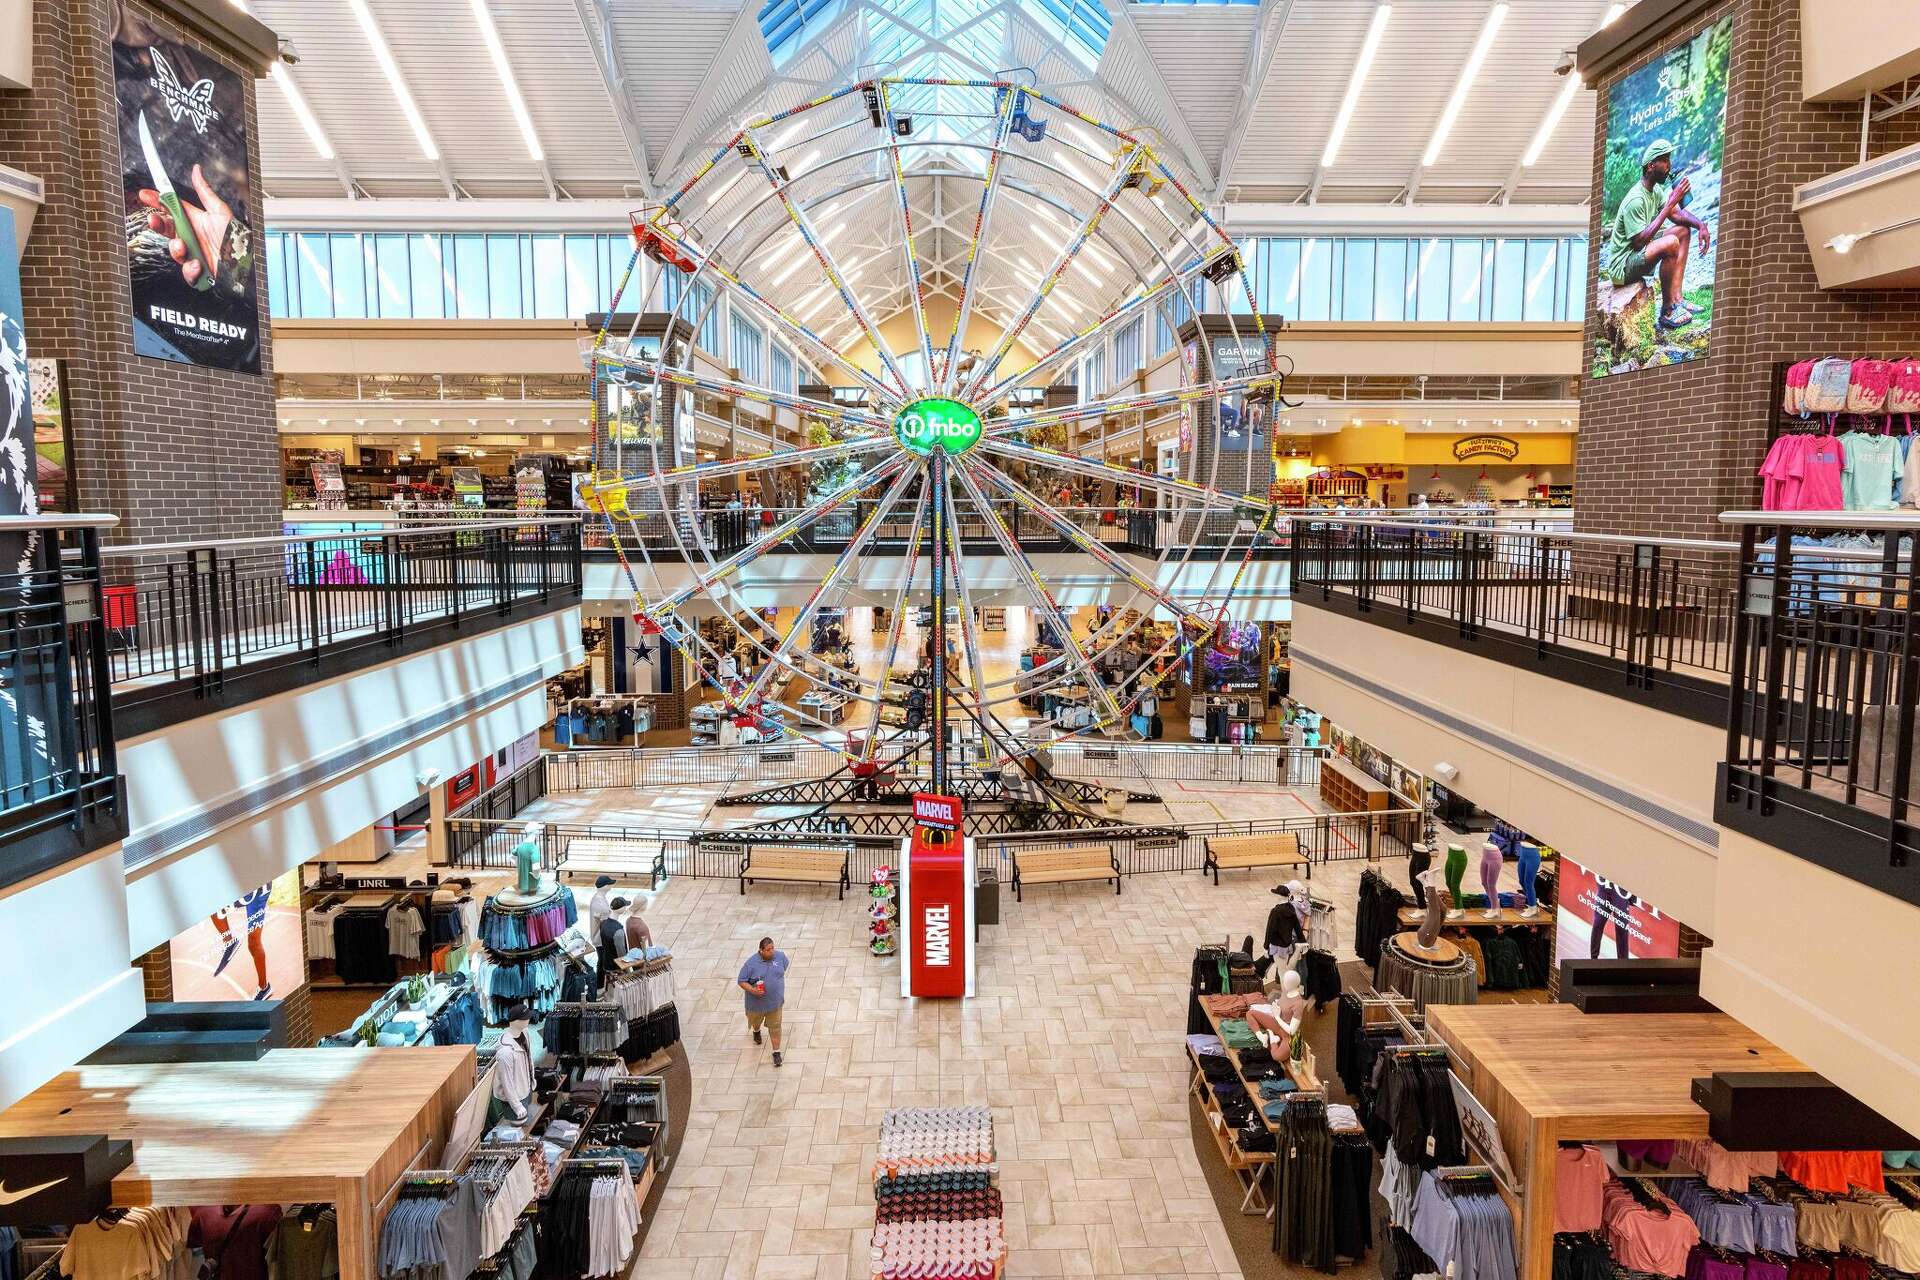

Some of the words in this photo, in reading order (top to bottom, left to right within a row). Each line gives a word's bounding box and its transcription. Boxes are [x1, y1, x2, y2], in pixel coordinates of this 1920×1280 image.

[150, 77, 219, 120] BENCHMADE
[1630, 102, 1663, 126] Hydro
[150, 305, 197, 328] FIELD
[199, 317, 247, 340] READY
[174, 327, 186, 336] The
[1218, 347, 1261, 356] GARMIN
[928, 416, 975, 437] fnbo
[1460, 444, 1483, 456] CANDY
[1484, 444, 1514, 457] FACTORY
[1540, 538, 1573, 548] SCHEE
[916, 800, 954, 820] MARVEL
[1136, 839, 1177, 847] SCHEELS
[358, 879, 390, 888] UNRL
[1586, 898, 1626, 928] Performance
[1605, 899, 1642, 928] Perspective
[925, 904, 950, 966] MARVEL
